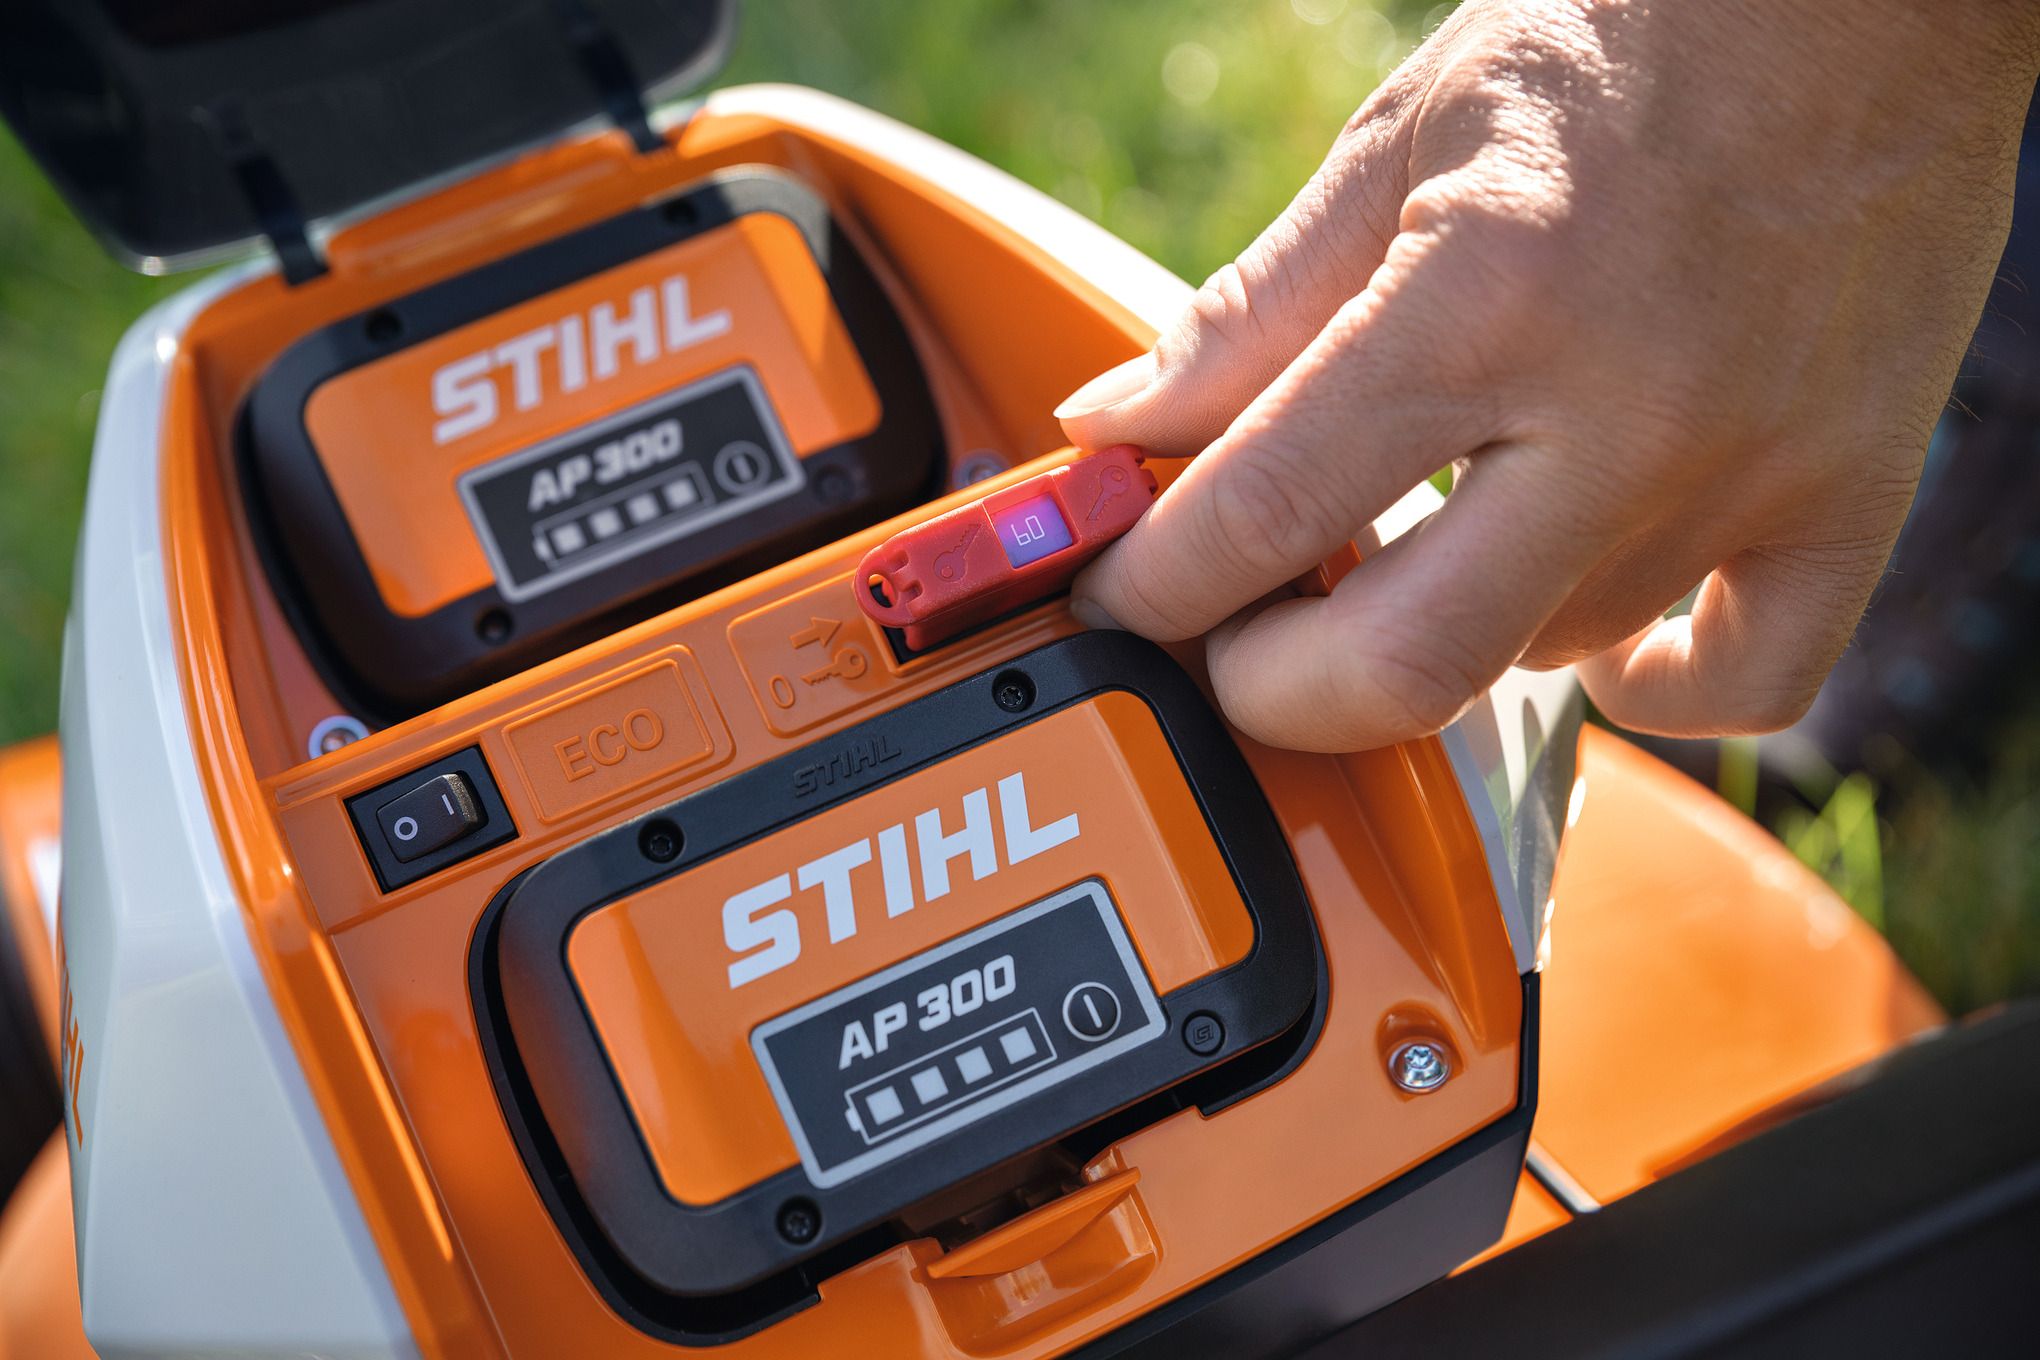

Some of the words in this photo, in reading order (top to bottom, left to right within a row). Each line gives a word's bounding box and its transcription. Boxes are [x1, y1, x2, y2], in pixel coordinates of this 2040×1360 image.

[431, 273, 732, 445] STIHL
[527, 454, 593, 511] AP
[593, 418, 684, 484] 300
[553, 707, 664, 783] ECO
[793, 735, 901, 798] STIHL
[721, 771, 1081, 989] STIHL
[838, 1001, 908, 1070] AP
[916, 954, 1017, 1032] 300
